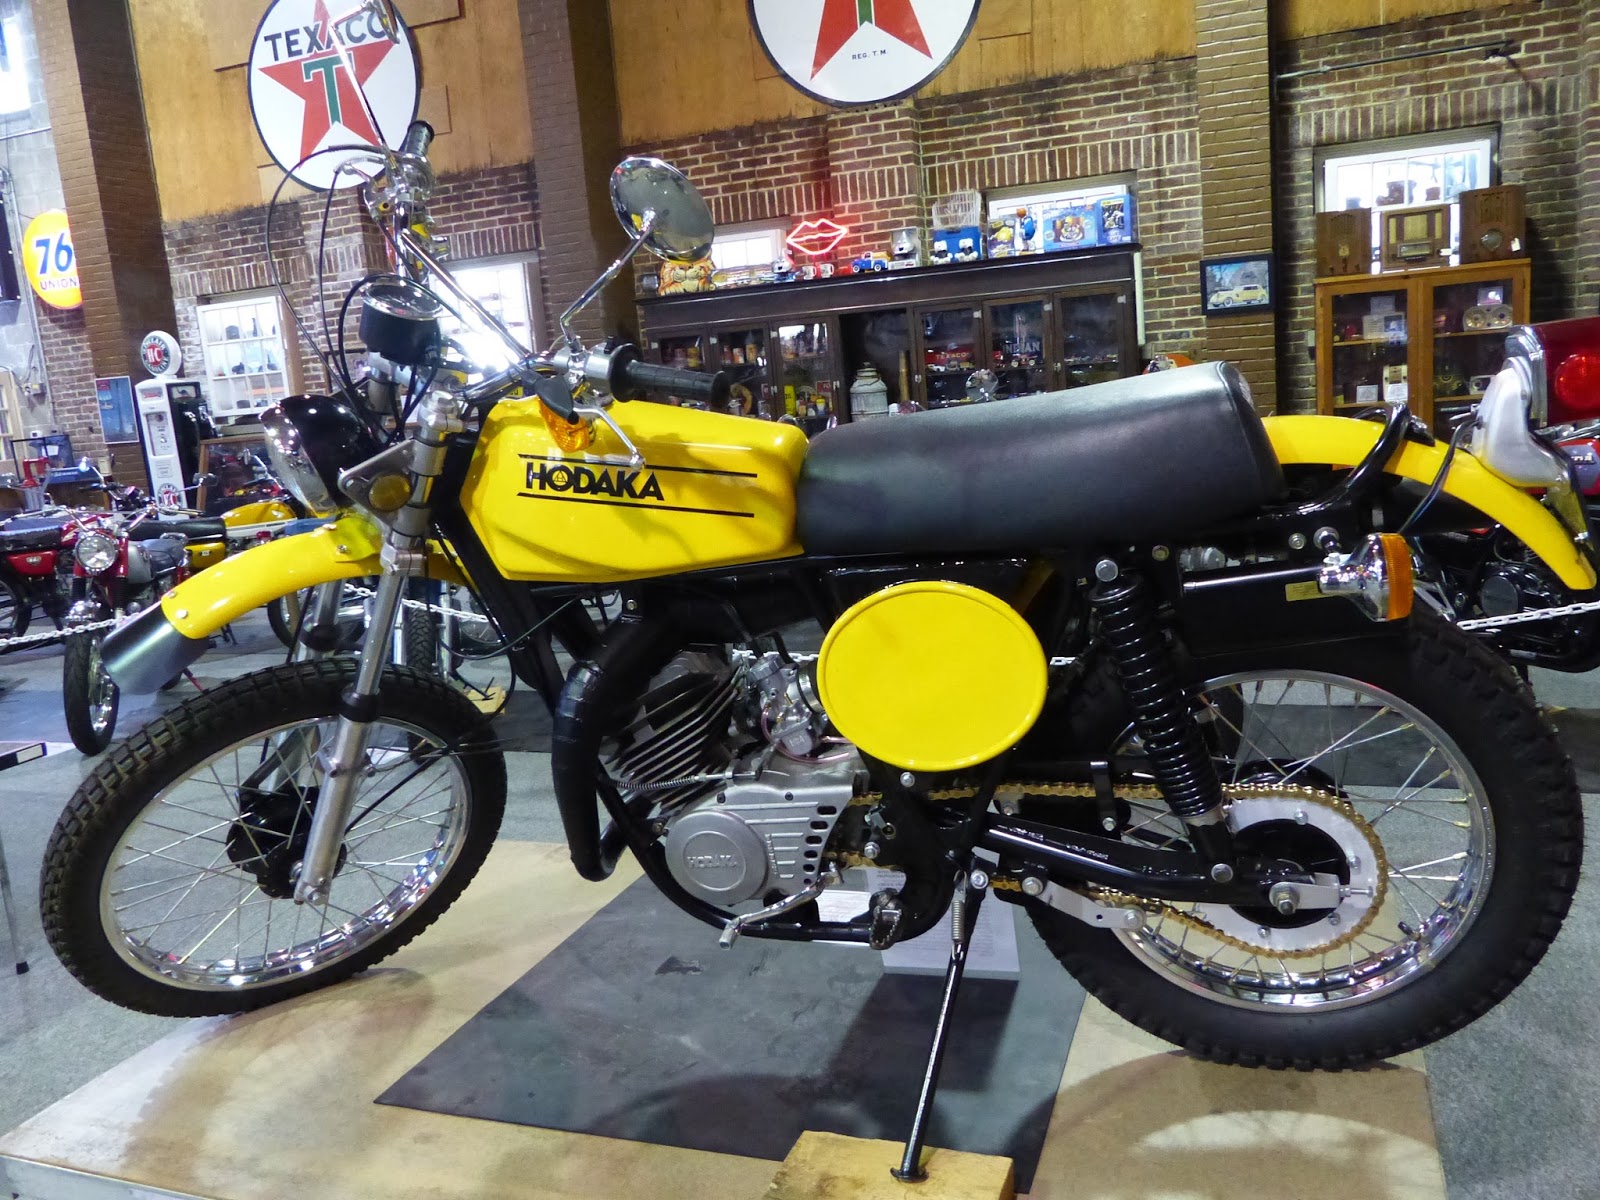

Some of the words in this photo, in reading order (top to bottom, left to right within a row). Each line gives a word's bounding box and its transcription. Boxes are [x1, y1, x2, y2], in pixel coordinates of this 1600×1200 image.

[851, 52, 870, 60] REG.
[303, 53, 354, 125] T
[35, 233, 73, 275] 76
[40, 278, 77, 290] UNION
[935, 352, 967, 360] TEXACO
[525, 462, 665, 501] HODAKA
